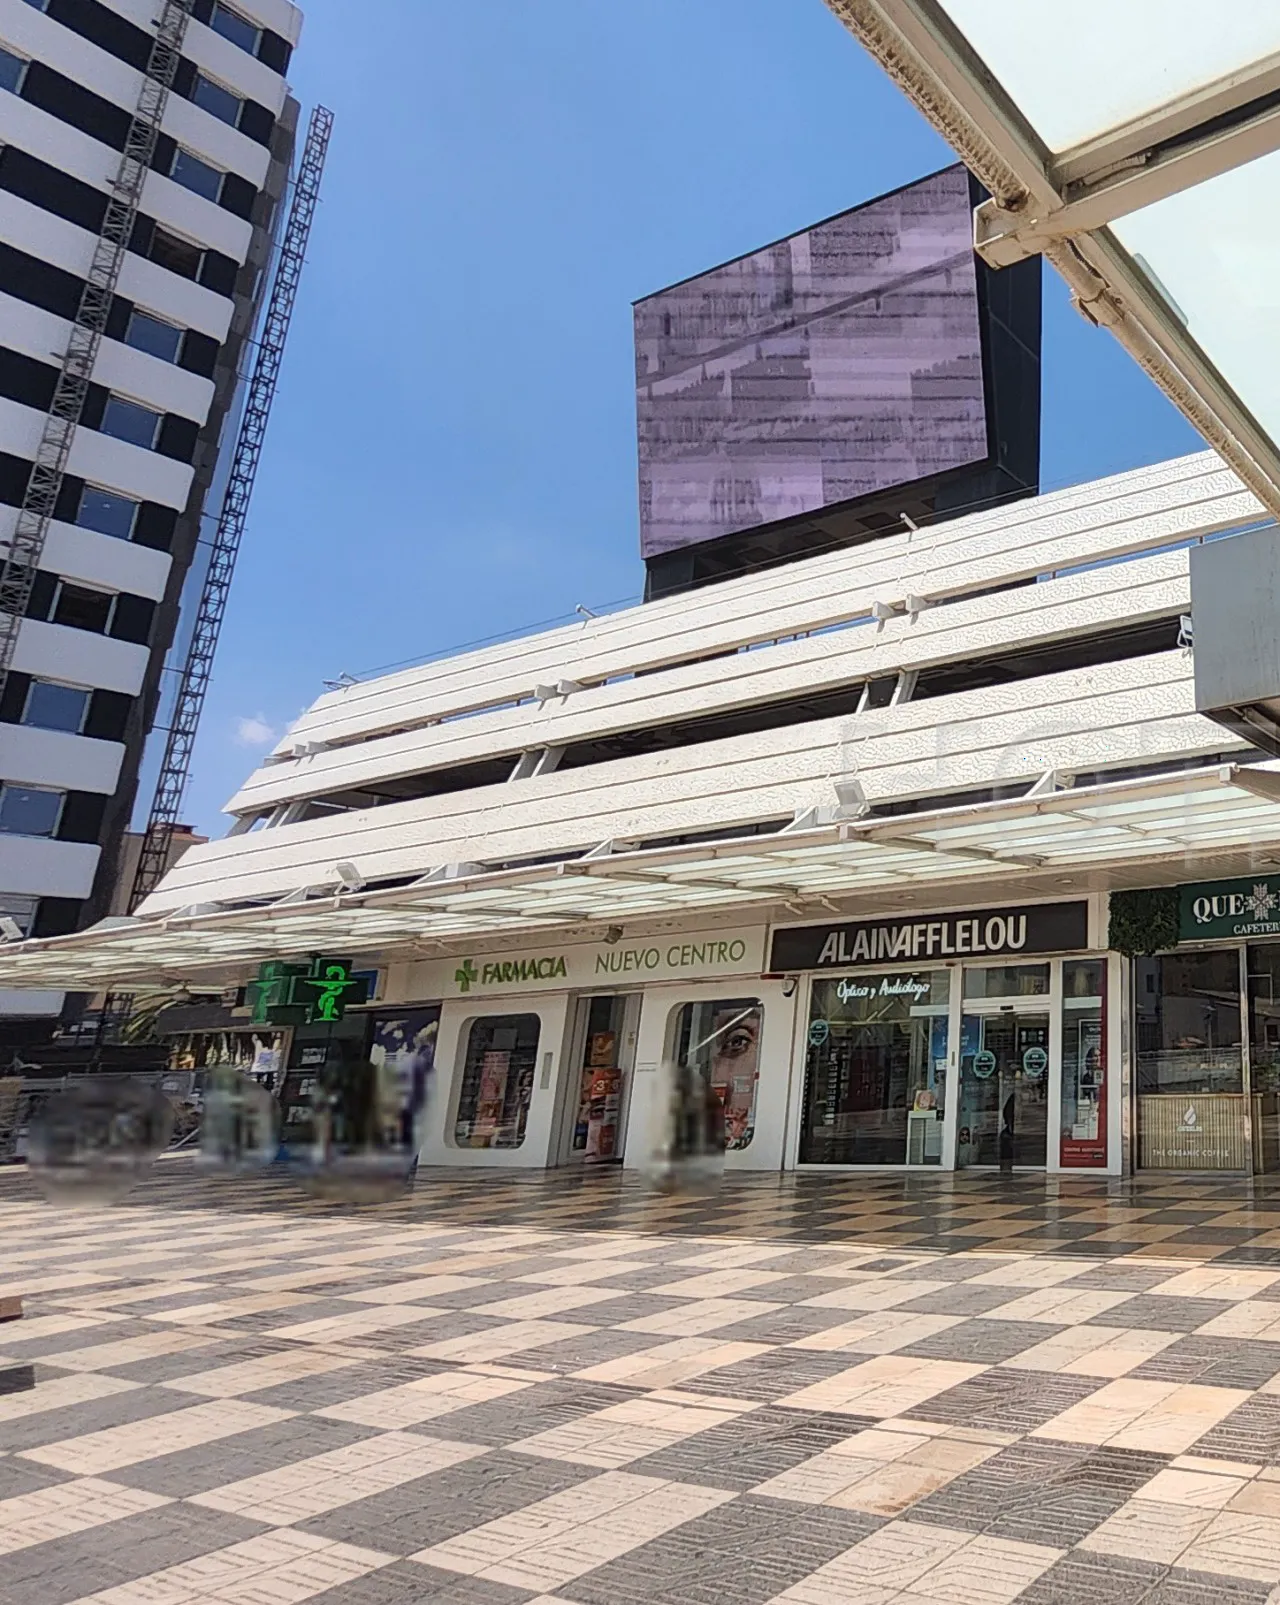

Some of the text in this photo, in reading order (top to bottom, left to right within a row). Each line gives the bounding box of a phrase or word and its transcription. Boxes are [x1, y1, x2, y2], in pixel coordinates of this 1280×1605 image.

[1192, 893, 1245, 924] QUE
[481, 939, 746, 985] FARMACIA NUEVO CENTRO
